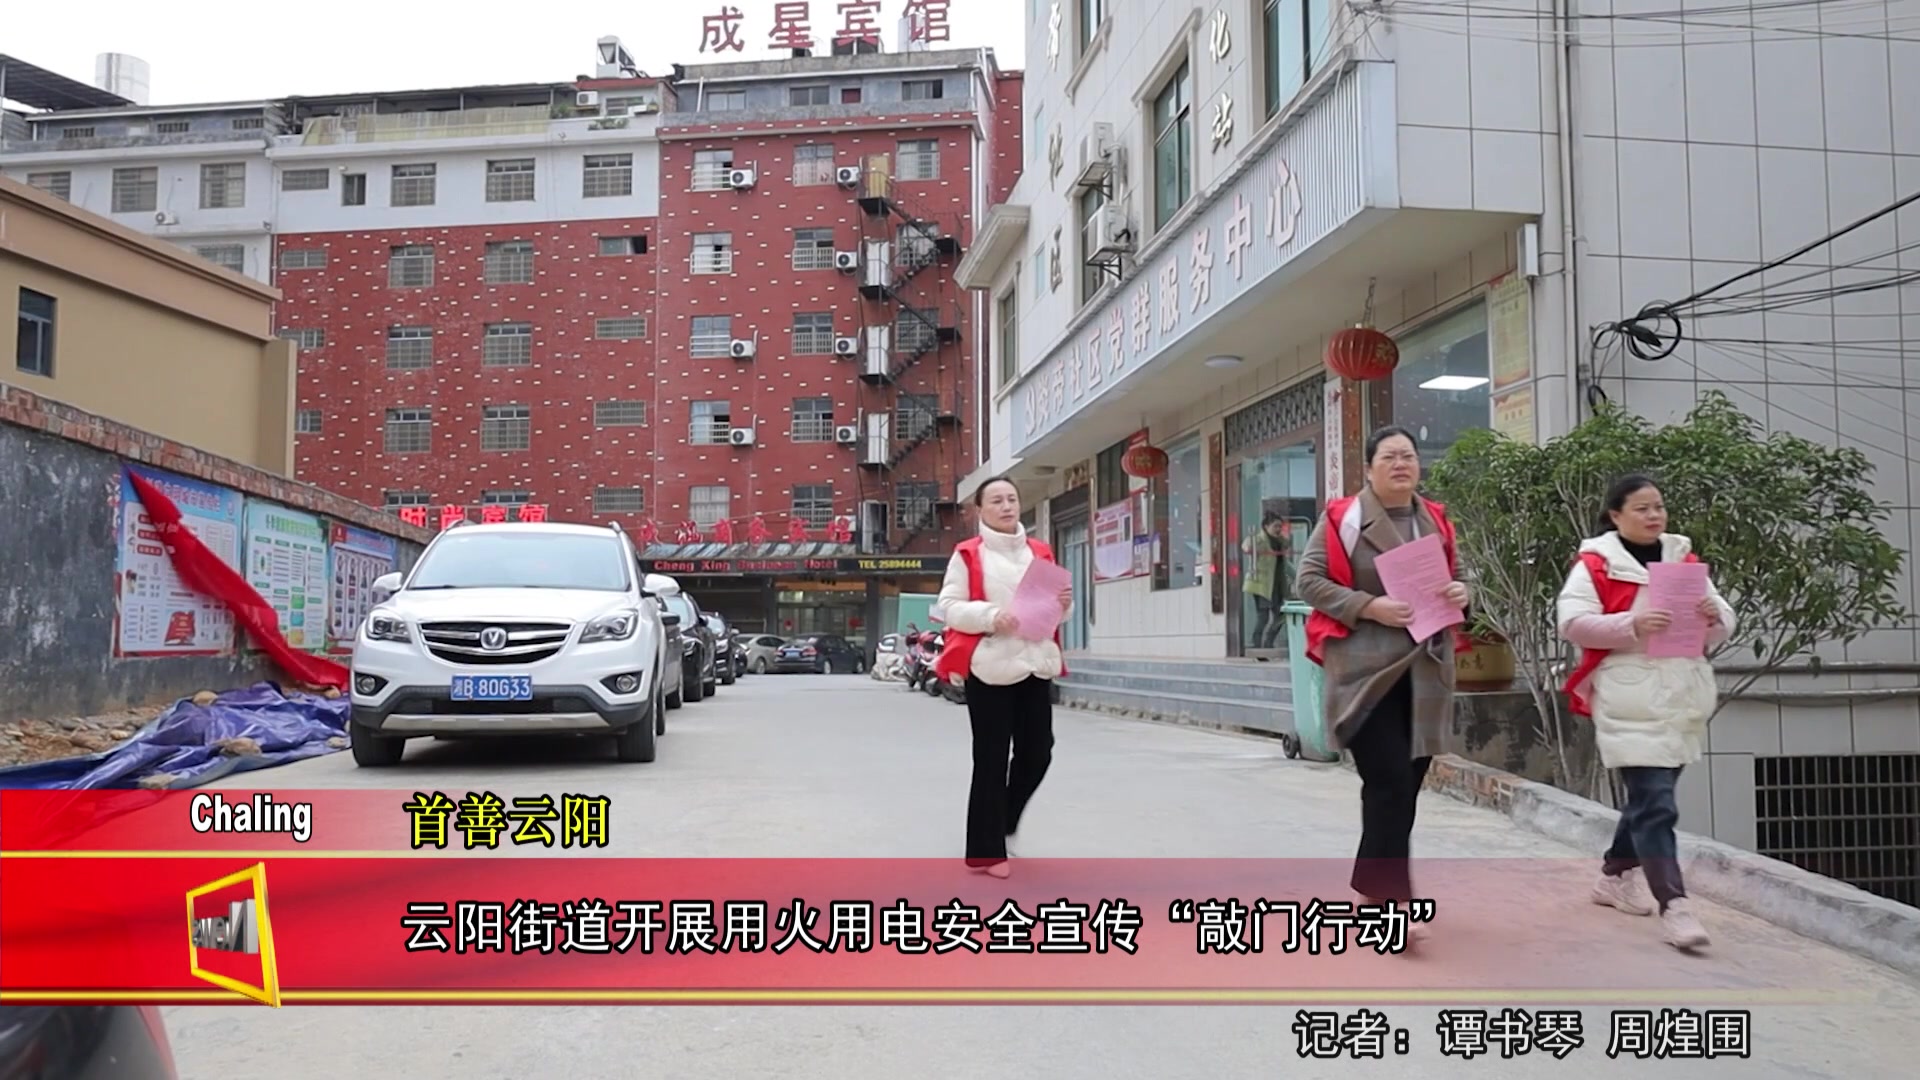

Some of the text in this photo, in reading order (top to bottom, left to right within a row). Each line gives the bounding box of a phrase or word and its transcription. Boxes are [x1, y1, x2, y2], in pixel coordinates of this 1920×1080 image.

[698, 0, 951, 53] 成星宾馆
[653, 559, 695, 572] Cheng
[701, 560, 731, 572] Xing
[857, 559, 876, 570] TEL
